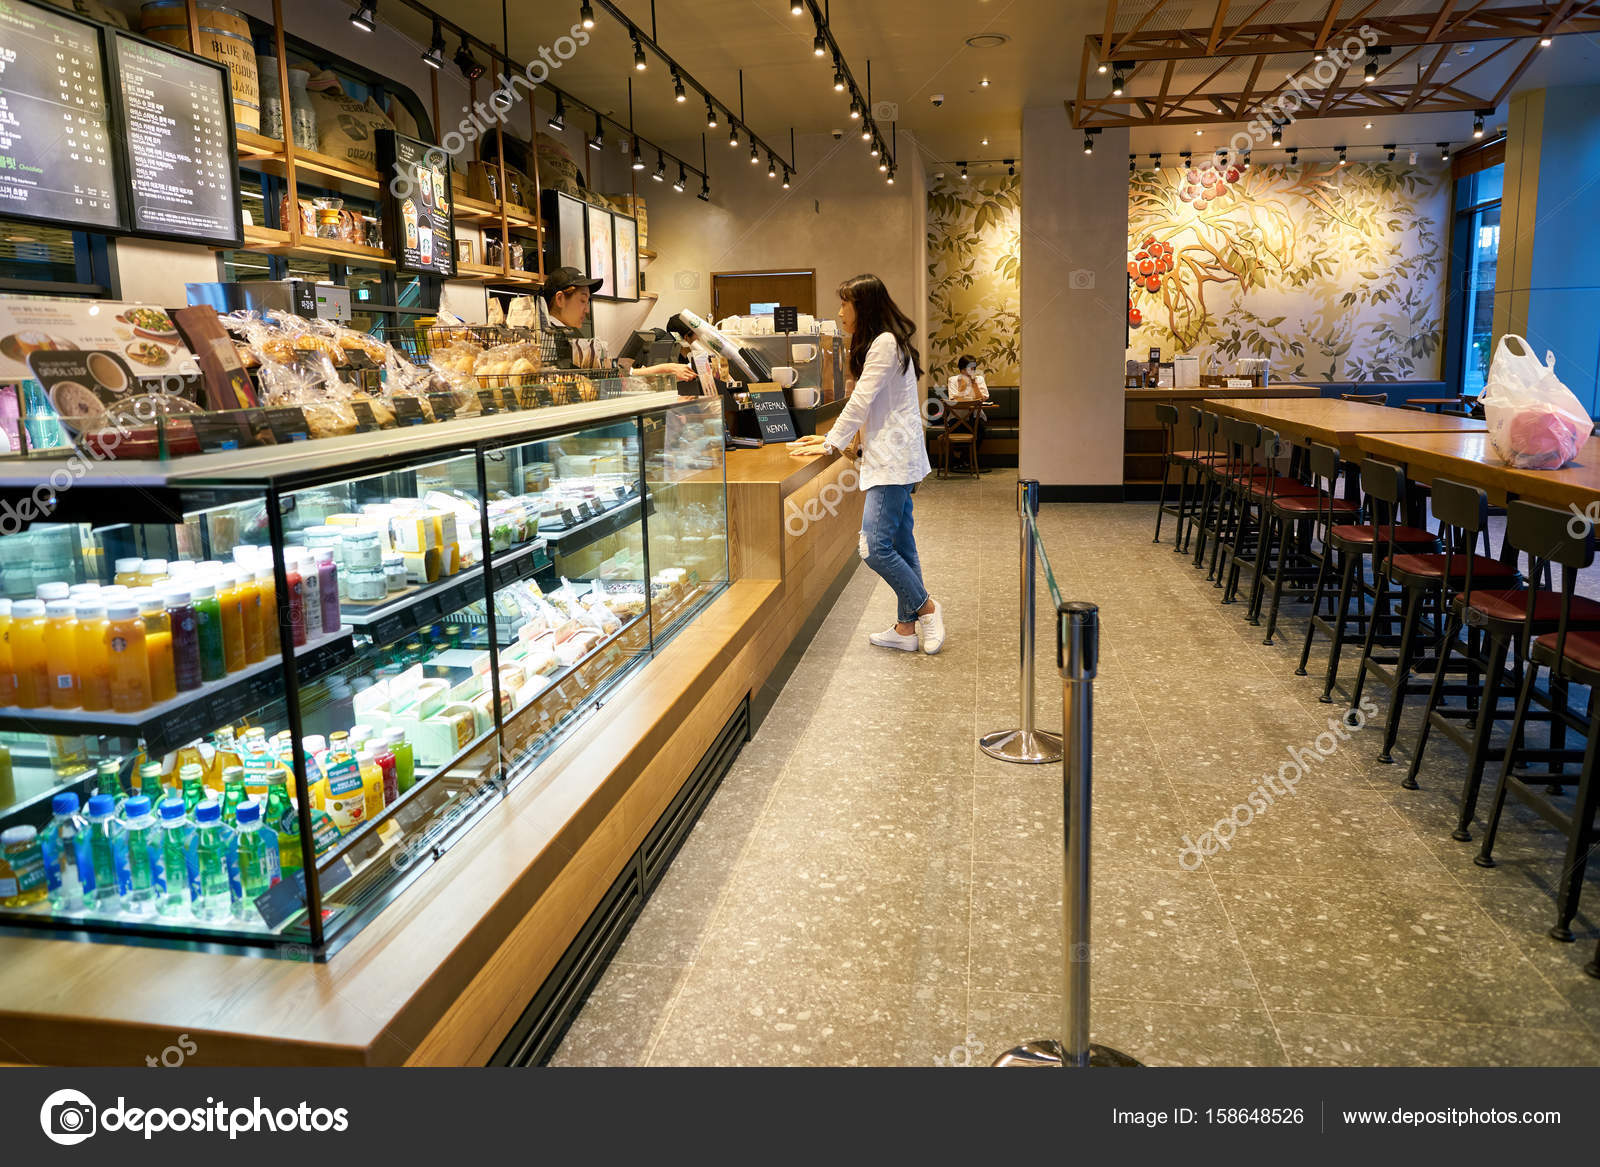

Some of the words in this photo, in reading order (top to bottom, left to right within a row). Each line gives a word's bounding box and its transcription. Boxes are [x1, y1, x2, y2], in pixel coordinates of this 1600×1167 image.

[212, 40, 239, 58] BLUE
[754, 401, 787, 411] GUATEMALA
[766, 424, 789, 434] KENYA
